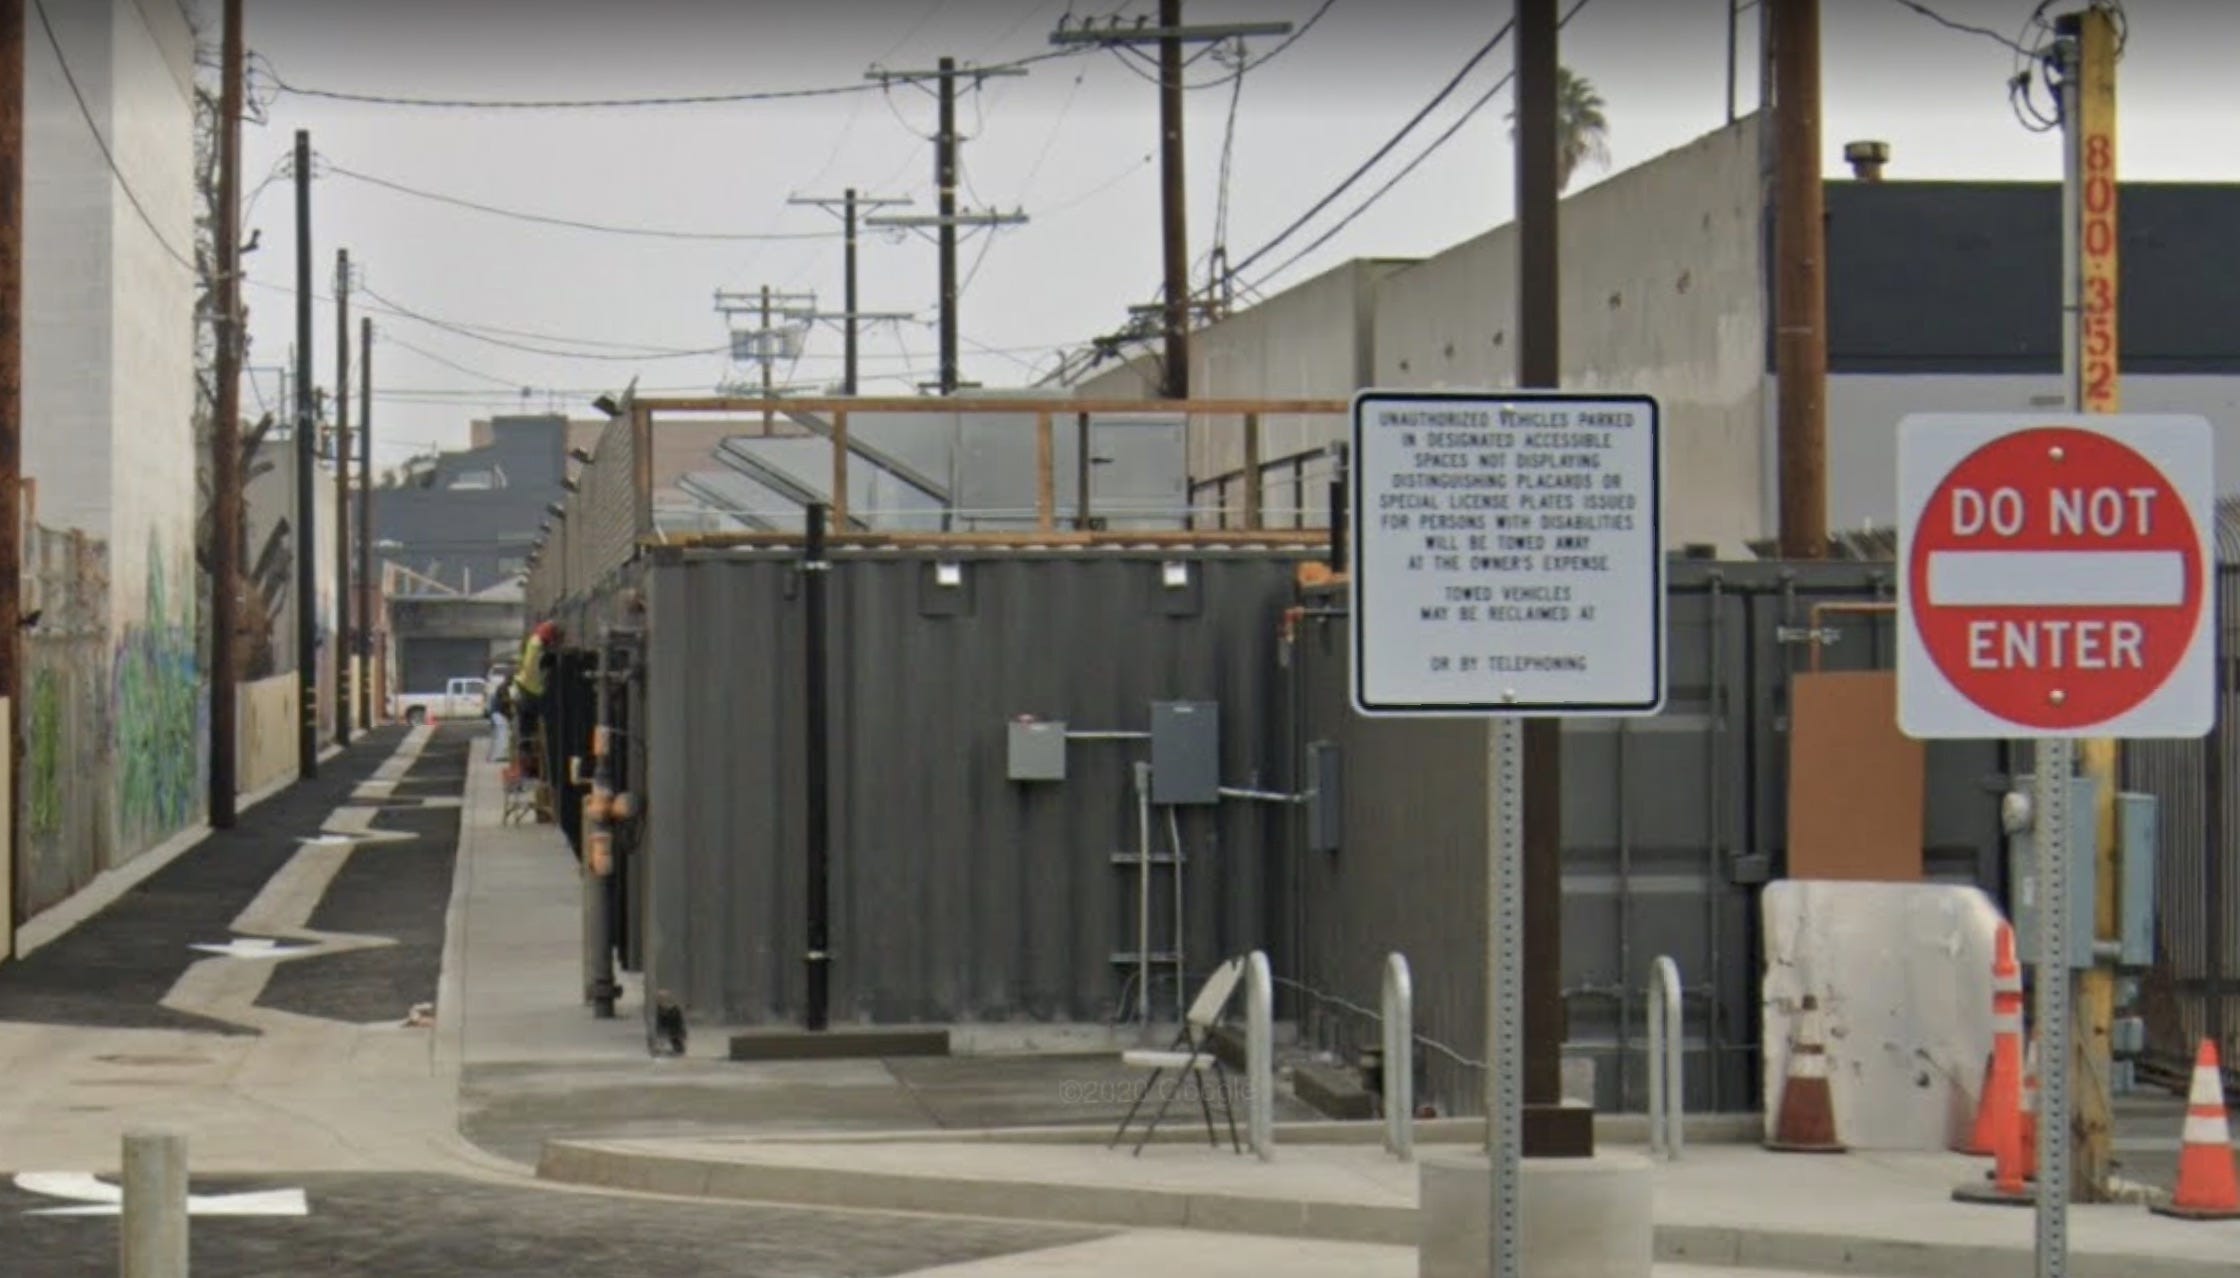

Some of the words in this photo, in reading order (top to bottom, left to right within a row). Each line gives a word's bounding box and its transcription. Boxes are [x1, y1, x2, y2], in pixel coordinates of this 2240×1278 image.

[1378, 412, 1489, 428] UNAUTHORIZED
[1500, 412, 1569, 428] VEHICLES
[1578, 412, 1635, 428] PARKED
[1402, 432, 1417, 448] IN
[1427, 432, 1515, 448] DESIGNATED
[1525, 432, 1612, 448] ACCESSIBLE
[1414, 452, 1468, 469] SPACES
[1479, 452, 1506, 469] NOT
[1516, 452, 1601, 469] DISPLAYING
[1392, 473, 1507, 490] DISTINGUISHING
[1516, 473, 1593, 490] PLACARDS
[1602, 473, 1622, 490] OR
[1379, 493, 1438, 510] SPECIAL
[1450, 493, 1509, 510] LICENSE
[1519, 493, 1573, 510] PLATES
[1583, 493, 1636, 510] ISSUED
[1951, 487, 2025, 536] DO
[2049, 487, 2158, 536] NOT
[1381, 513, 1410, 530] FOR
[1419, 513, 1486, 530] PERSONS
[1495, 513, 1531, 530] WITH
[1540, 513, 1634, 530] DISABILITIES
[1425, 534, 1458, 551] WILL
[1469, 534, 1487, 551] BE
[1497, 534, 1546, 551] TOWED
[1555, 534, 1590, 551] AWAY
[1407, 555, 1424, 571] AT
[1434, 555, 1460, 571] THE
[1470, 555, 1534, 571] OWNER'S
[1543, 555, 1609, 571] EXPENSE
[1445, 585, 1493, 602] TOWED
[1502, 585, 1572, 602] VEHICLES
[1420, 605, 1449, 621] MAY
[1459, 605, 1478, 621] BE
[1489, 605, 1570, 621] RECLAIMED
[1580, 605, 1596, 621] AT
[1968, 620, 2144, 669] ENTER
[1430, 655, 1450, 672] OR
[1460, 655, 1478, 672] BY
[1488, 655, 1587, 672] TELEPHONING
